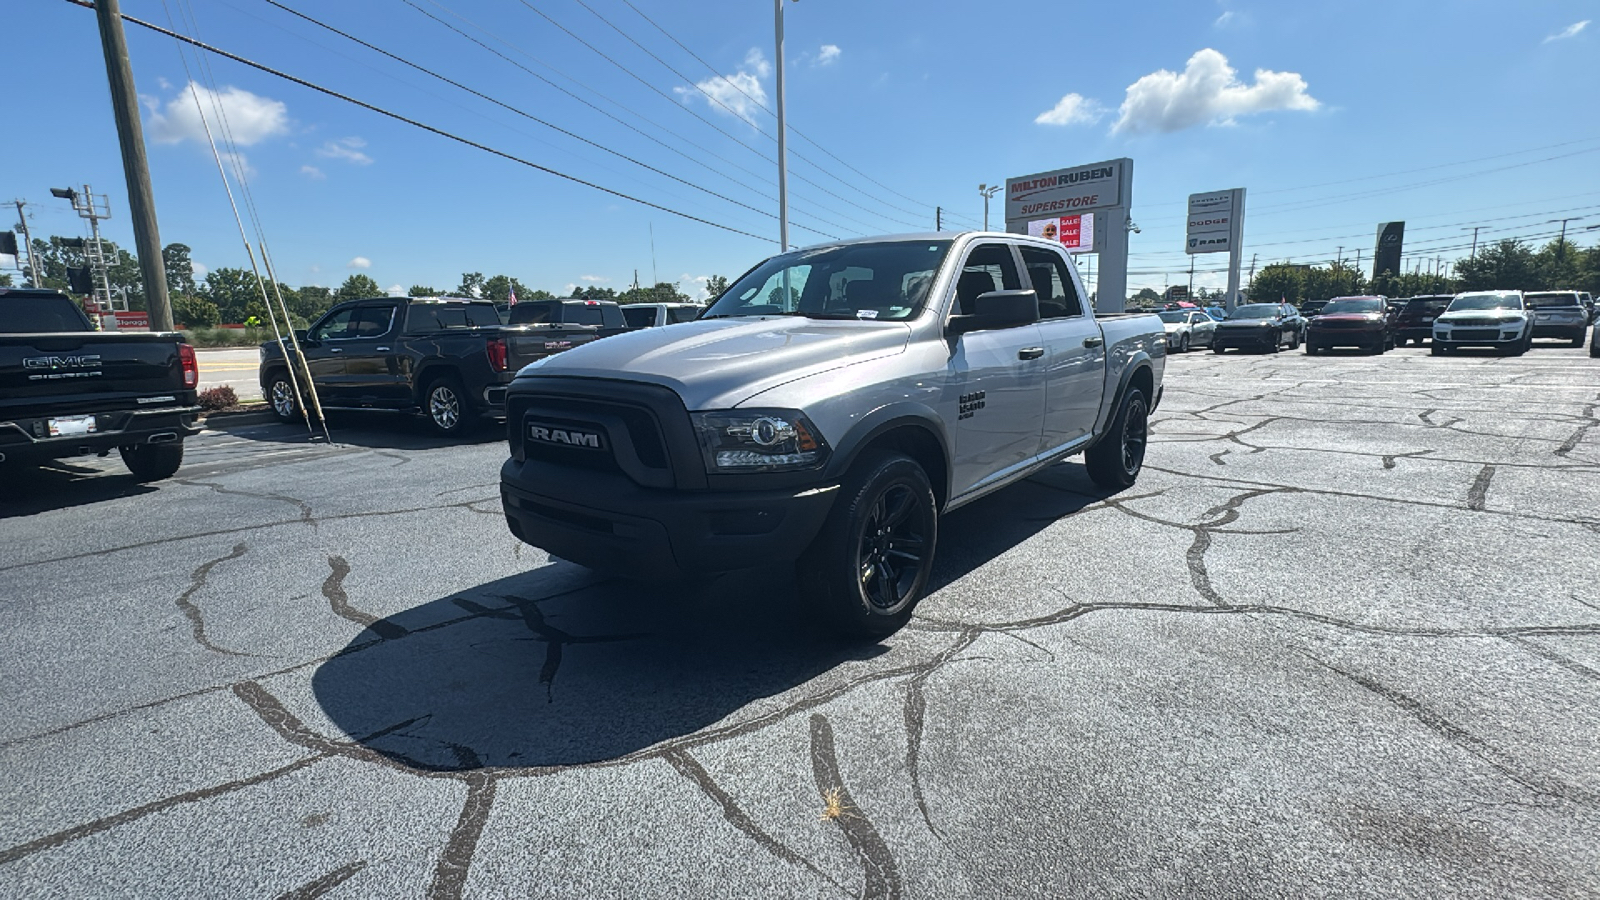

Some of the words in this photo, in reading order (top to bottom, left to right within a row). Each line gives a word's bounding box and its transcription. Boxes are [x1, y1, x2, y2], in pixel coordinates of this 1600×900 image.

[1021, 195, 1099, 214] SUPERSTORE
[1190, 218, 1229, 227] DODGE
[23, 355, 102, 369] GMC
[28, 371, 103, 381] SIERRA
[531, 426, 599, 448] RAM
